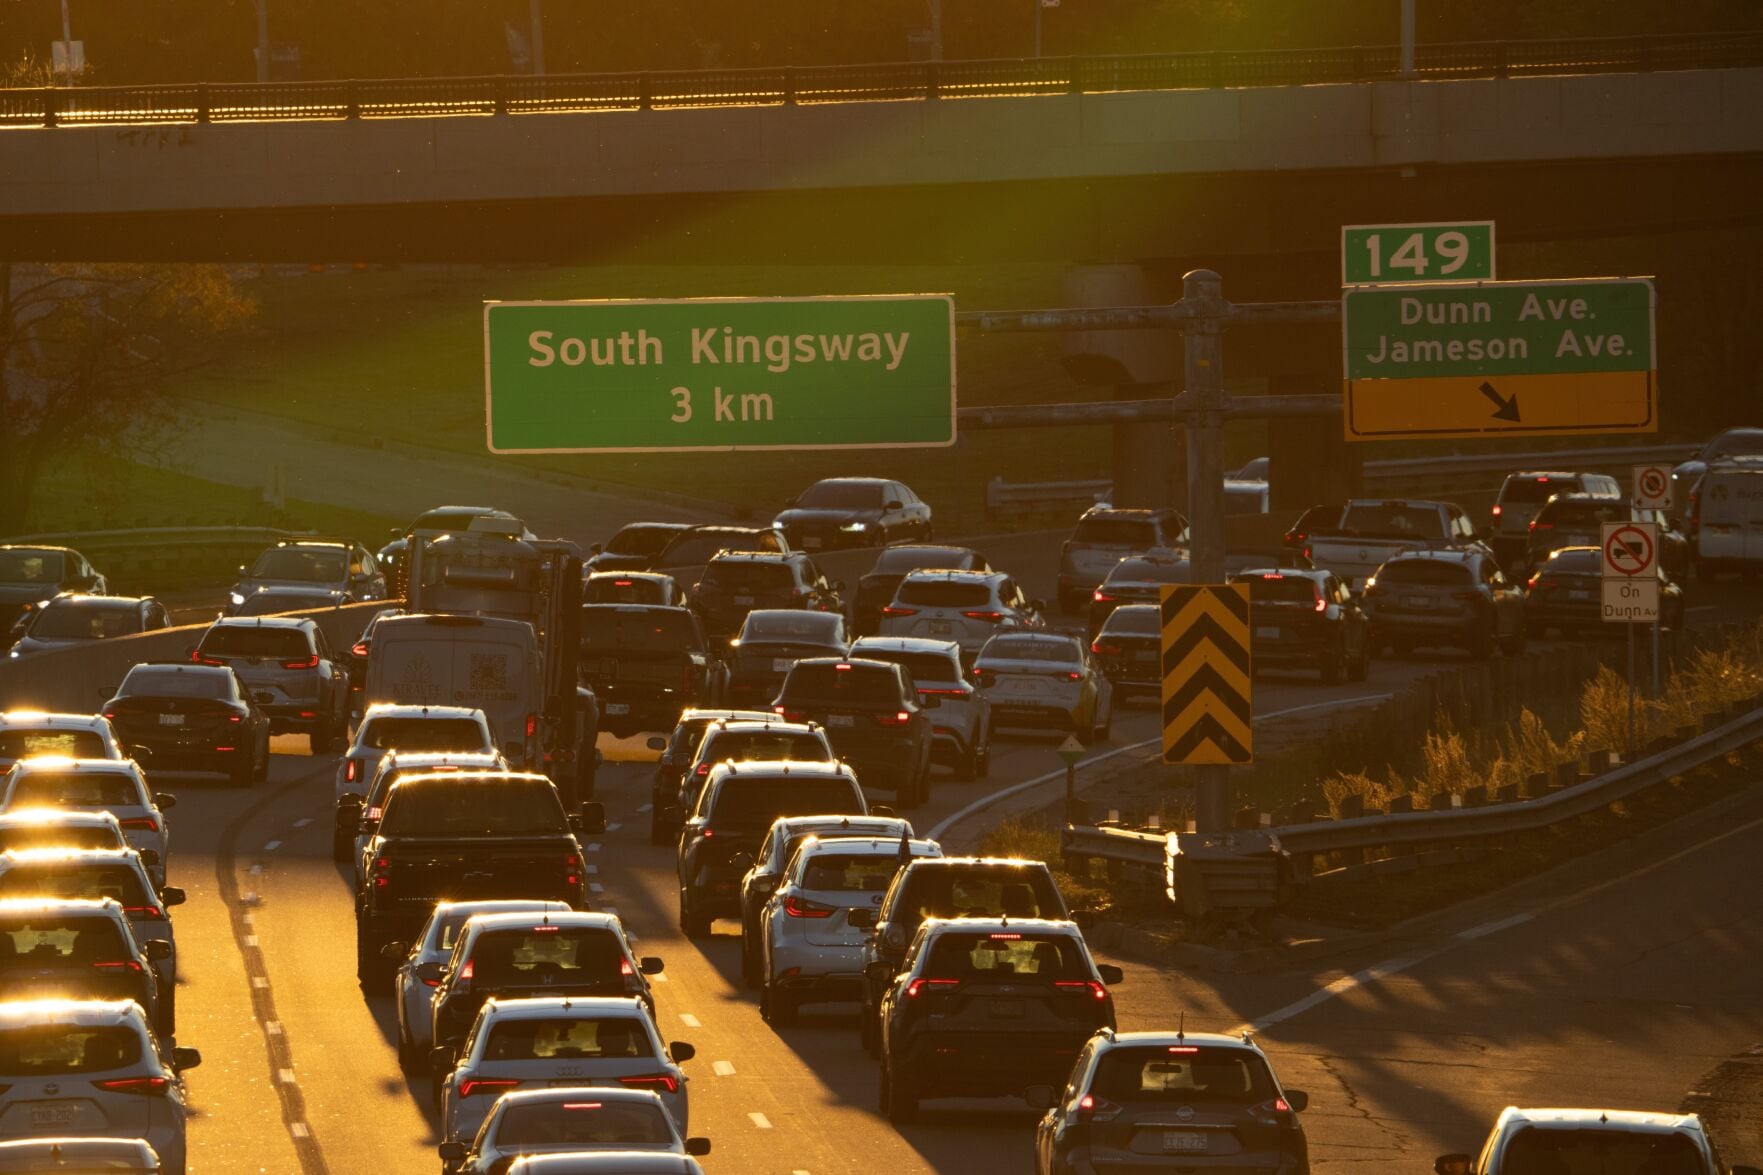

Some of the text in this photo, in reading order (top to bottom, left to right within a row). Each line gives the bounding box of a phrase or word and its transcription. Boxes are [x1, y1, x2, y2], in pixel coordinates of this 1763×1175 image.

[1366, 231, 1470, 277] 149
[1401, 293, 1597, 326] Dunn Ave.
[528, 326, 911, 373] South Kingsway
[1366, 329, 1634, 364] Jameson Ave.
[670, 386, 774, 423] 3 km
[1620, 586, 1640, 598] On
[1604, 605, 1641, 617] Dunn
